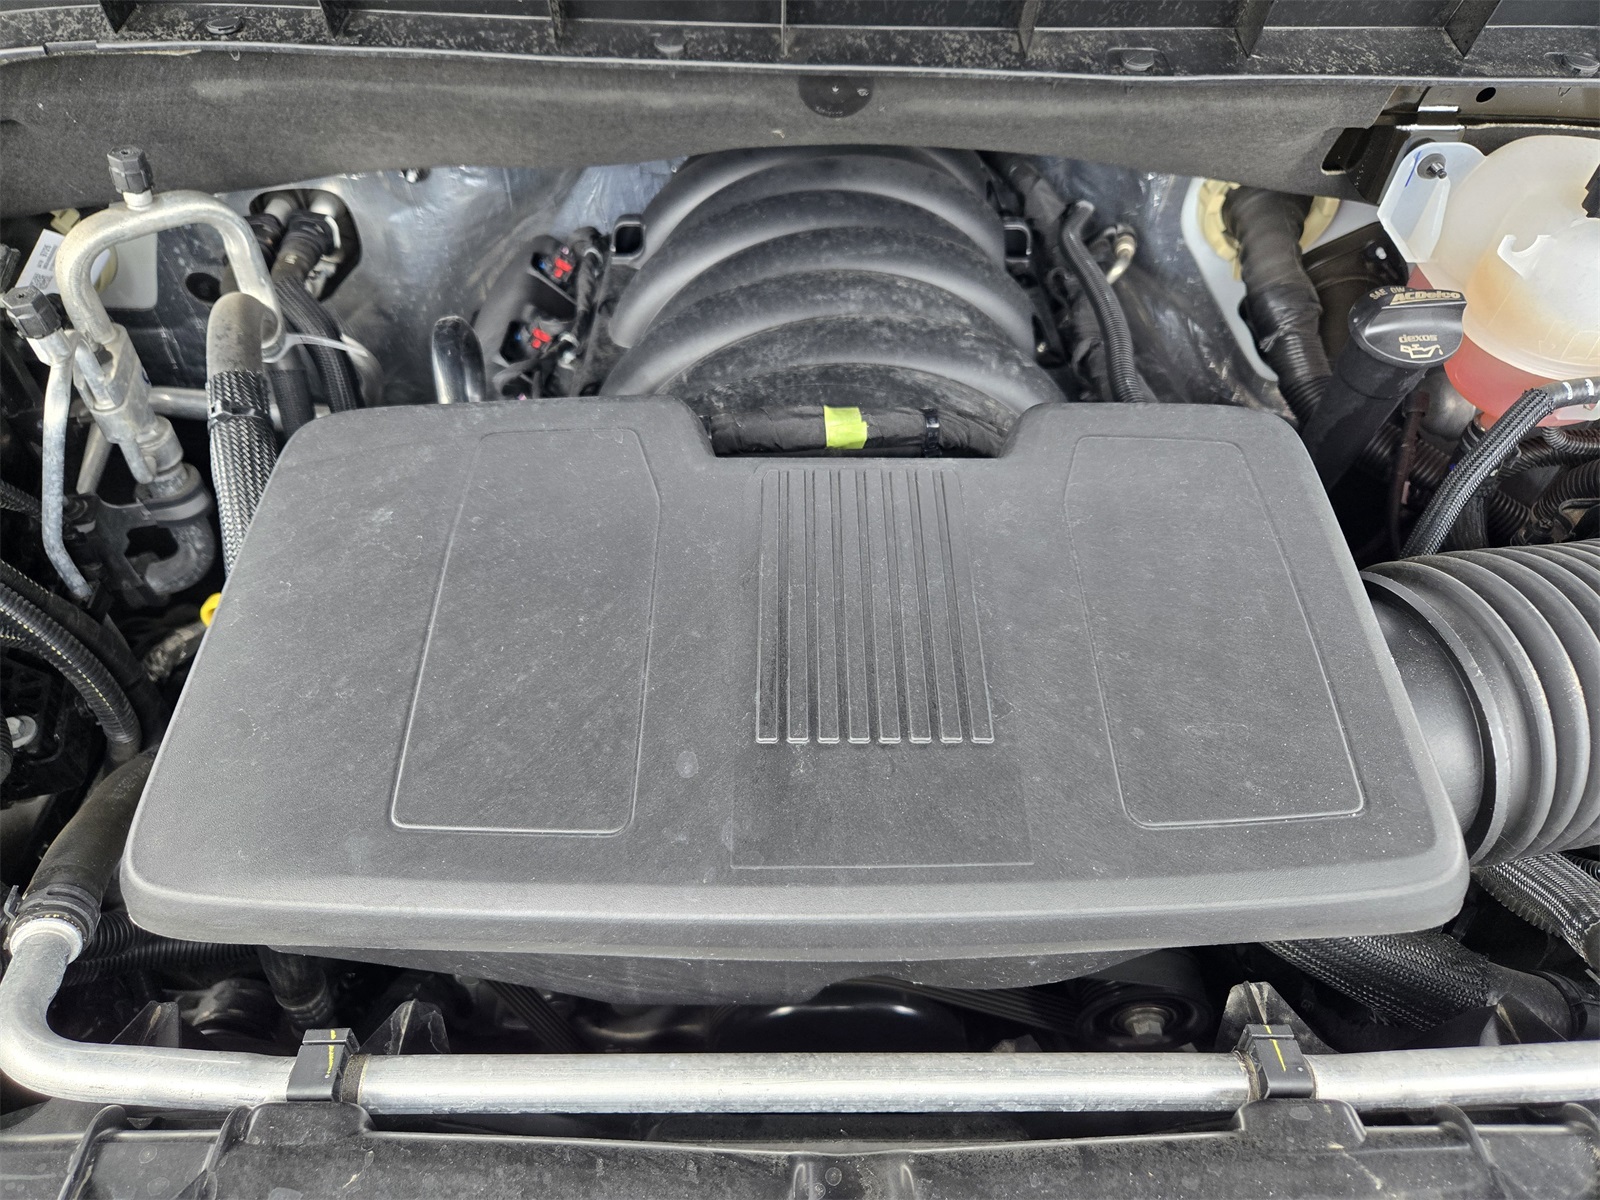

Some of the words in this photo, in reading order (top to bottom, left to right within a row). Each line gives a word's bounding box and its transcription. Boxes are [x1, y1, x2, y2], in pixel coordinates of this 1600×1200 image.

[1369, 288, 1388, 300] SAE
[1390, 291, 1461, 304] ACDelco
[1398, 334, 1438, 343] dexos
